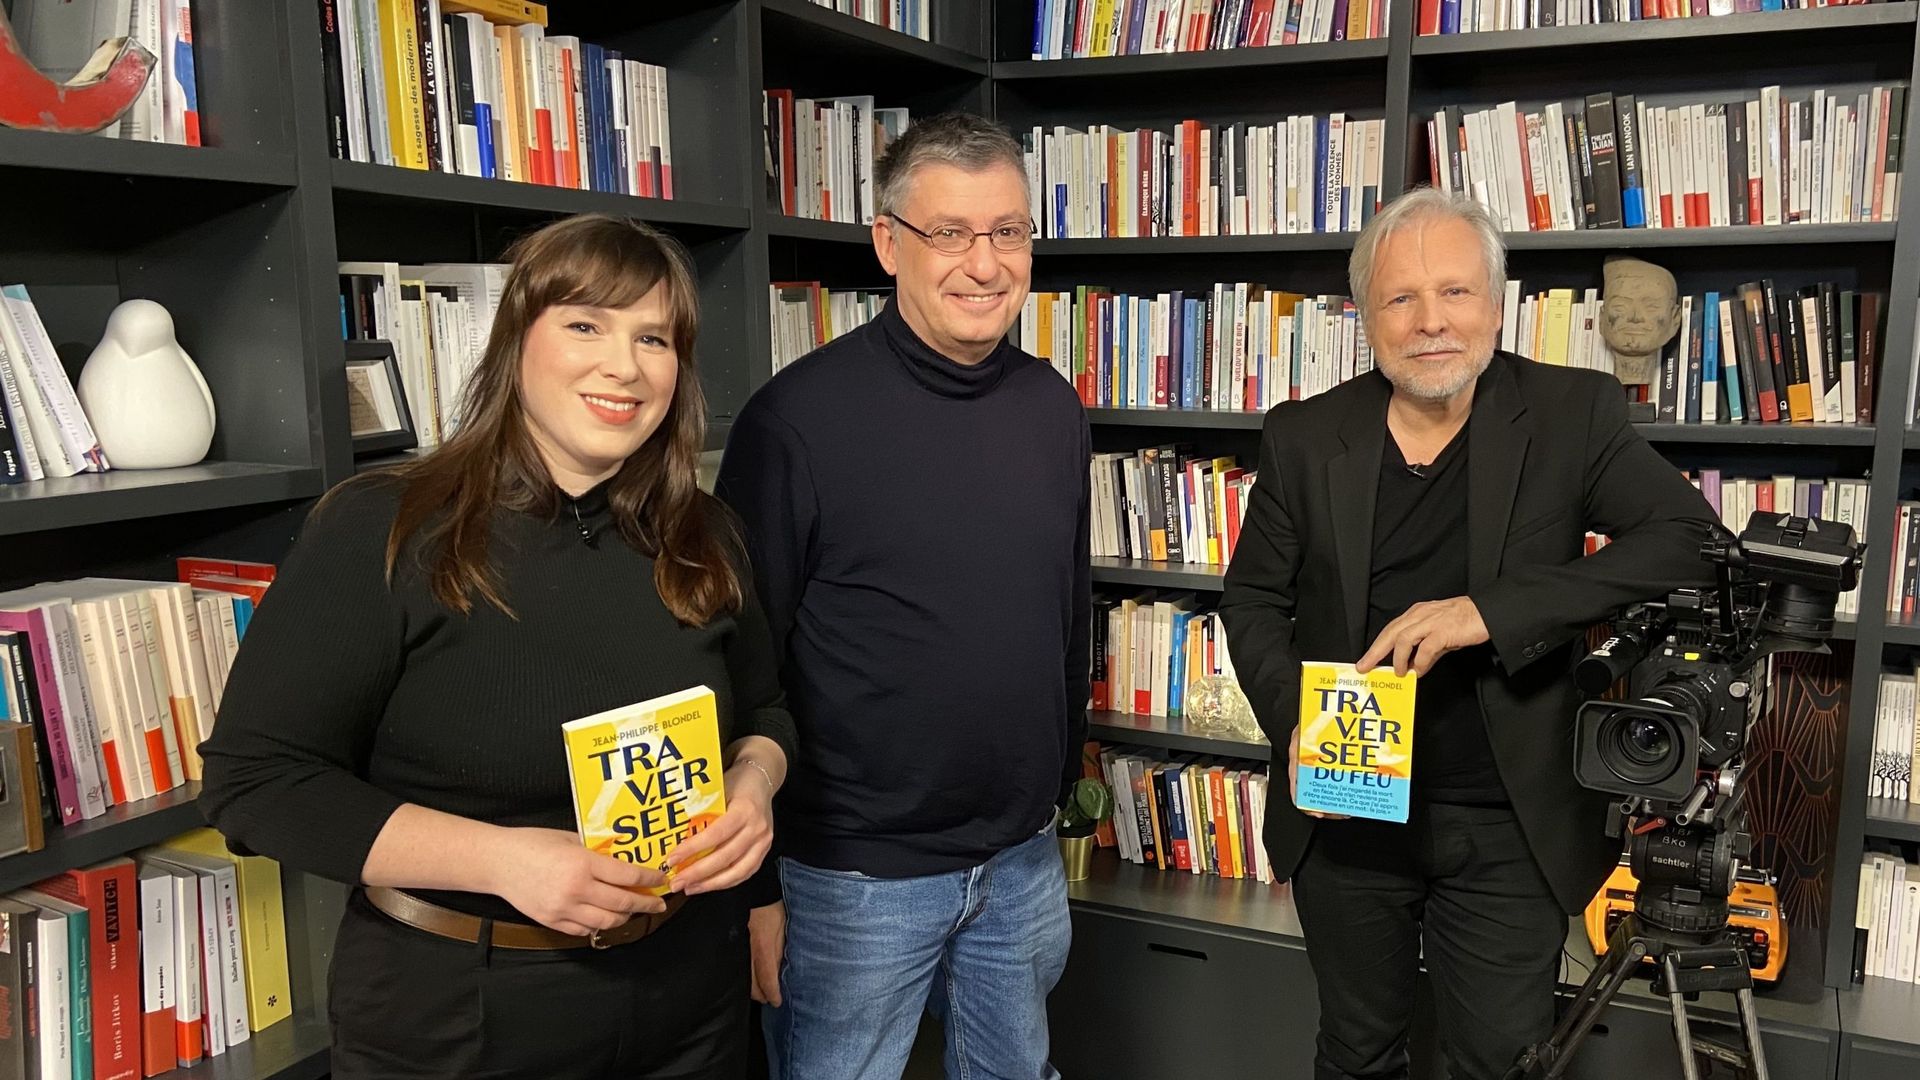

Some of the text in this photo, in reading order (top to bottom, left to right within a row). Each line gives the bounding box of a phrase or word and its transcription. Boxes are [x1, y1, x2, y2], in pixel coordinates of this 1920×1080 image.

[424, 41, 436, 95] LA VOLTE
[405, 28, 423, 164] La sagesse des modernes
[577, 105, 585, 143] BRIDA
[1622, 112, 1635, 170] IAN MANOOK
[1334, 151, 1342, 185] HOMMES
[1532, 166, 1544, 192] NTU
[1328, 179, 1335, 189] LA
[1327, 190, 1335, 215] TOUTE
[1236, 339, 1242, 348] DE
[1234, 349, 1242, 382] QUELQU'UN
[3, 450, 16, 478] fayard
[1163, 463, 1171, 488] BAVARDS
[1166, 504, 1174, 532] CADAVRES
[1839, 509, 1851, 523] SSE
[1319, 677, 1403, 690] JEAN-PHILIPPE BLONDEL
[1314, 688, 1382, 716] TRA
[592, 710, 702, 747] JEAN-PHILIPPE BLONDEL
[1334, 715, 1401, 744] VER
[587, 734, 683, 782] TRA
[1318, 736, 1380, 768] SÉE
[624, 757, 711, 806] VER
[1314, 767, 1392, 789] DU FEU
[613, 796, 691, 846] SÉE
[613, 841, 653, 865] DU
[1652, 856, 1690, 869] sachtler
[228, 929, 237, 945] Leroy
[230, 947, 238, 960] pour
[104, 879, 123, 1059] Boris Jitkov Viktor VAVITCH
[230, 962, 239, 983] Ballade
